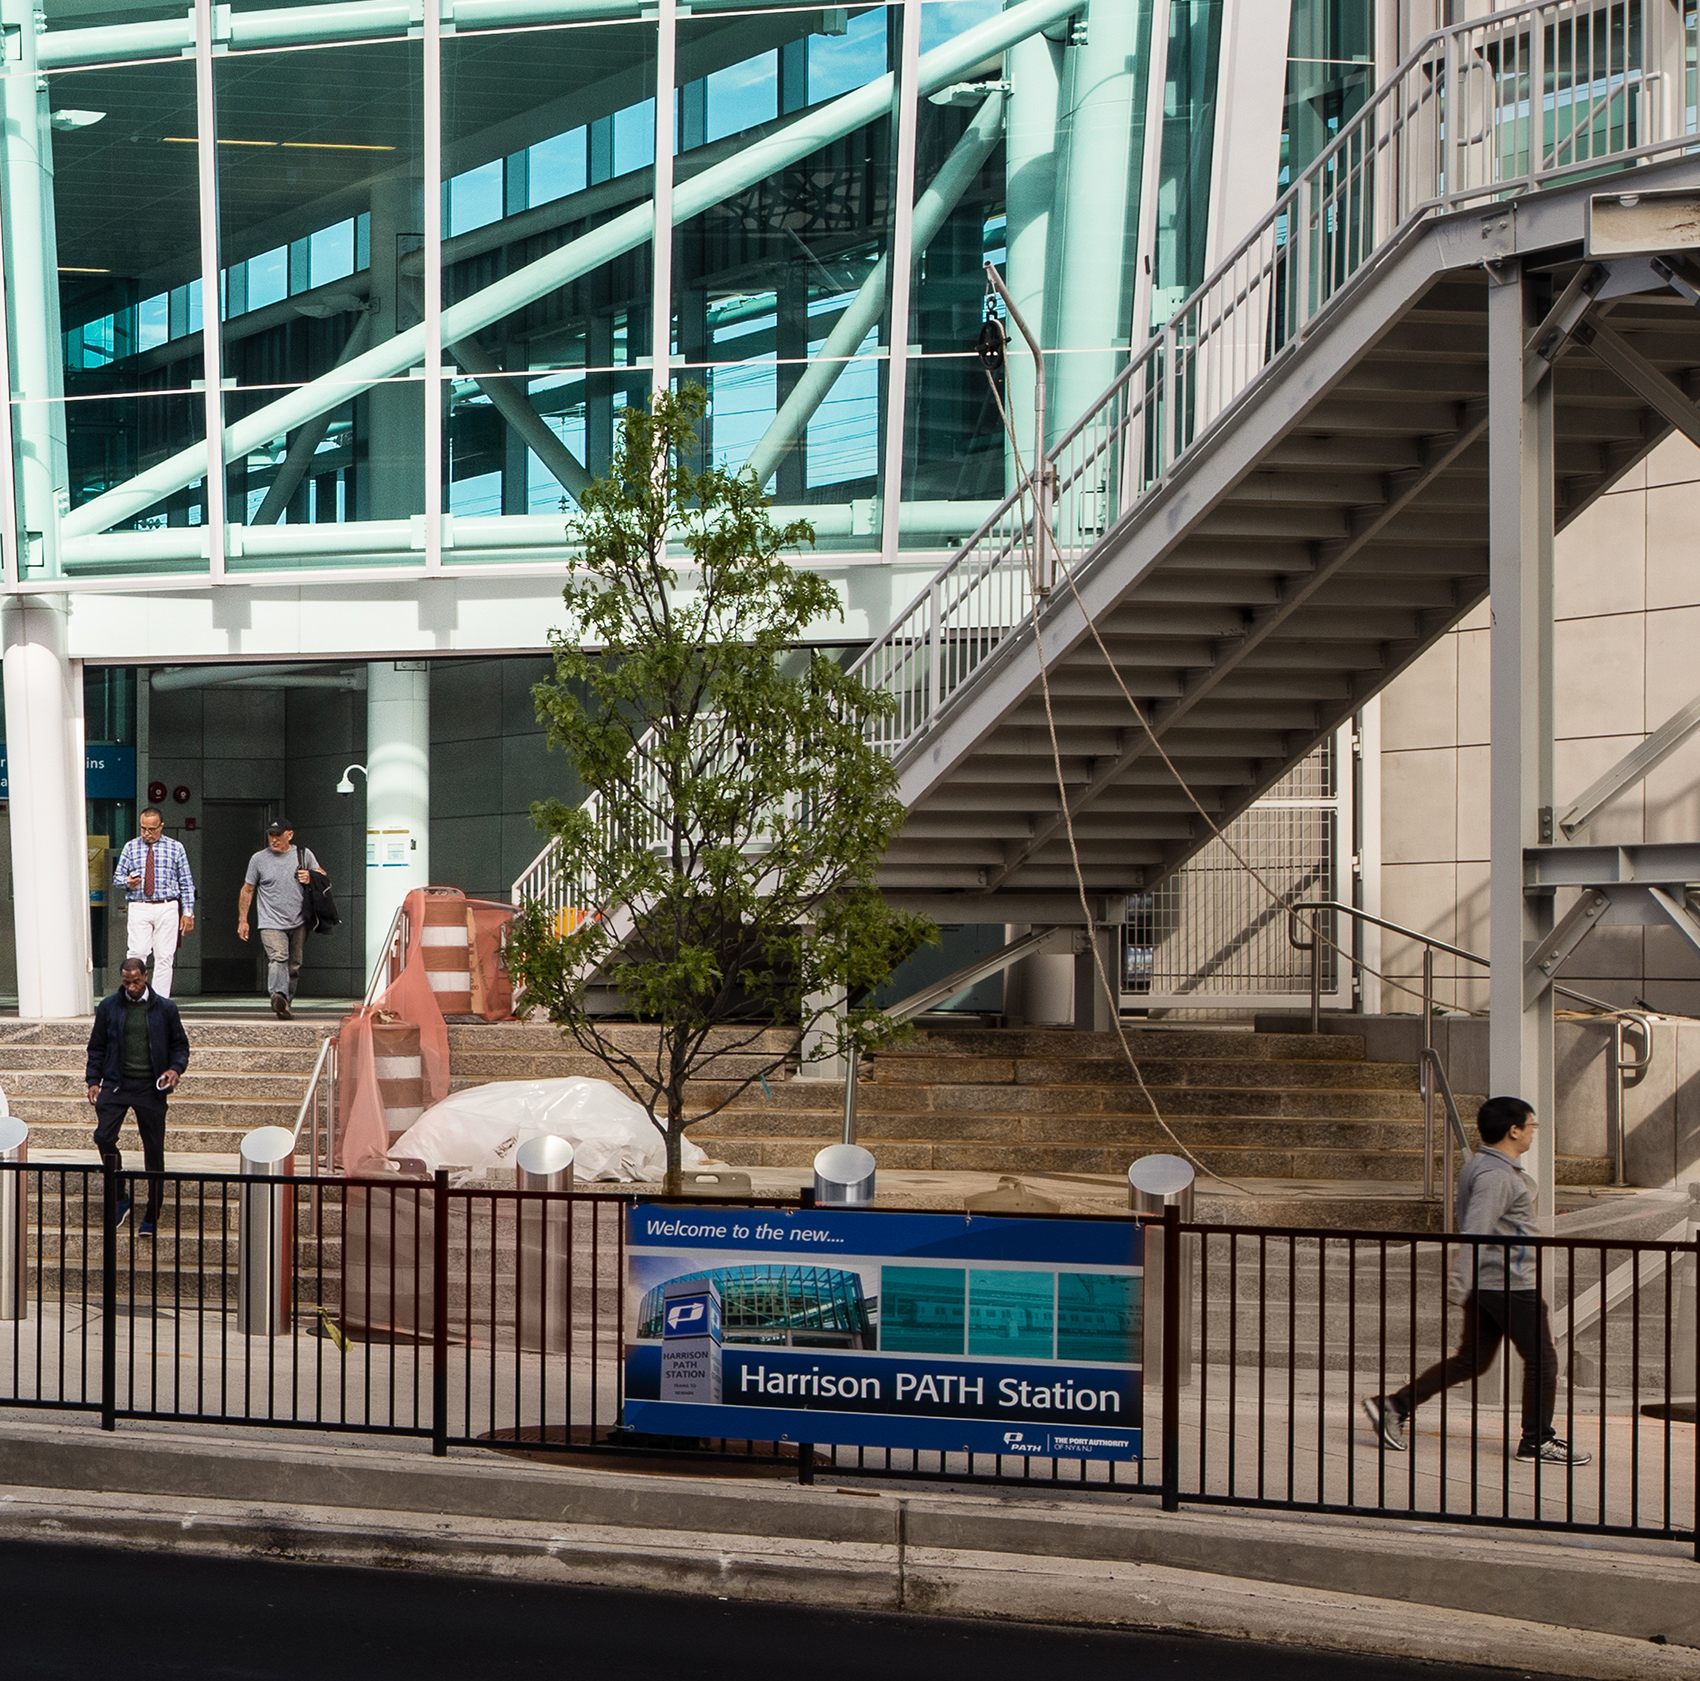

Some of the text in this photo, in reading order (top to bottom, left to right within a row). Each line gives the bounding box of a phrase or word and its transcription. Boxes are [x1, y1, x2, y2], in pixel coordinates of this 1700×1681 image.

[646, 1219, 727, 1238] Welcome
[732, 1224, 750, 1239] to
[755, 1223, 785, 1241] the
[663, 1351, 709, 1360] HARRISON
[673, 1361, 698, 1369] PATH
[665, 1370, 706, 1379] STATION
[740, 1364, 881, 1400] Harrison
[895, 1372, 984, 1405] PATH
[997, 1377, 1121, 1413] Station
[1054, 1436, 1129, 1448] THE PORT AUTHORITY
[1010, 1443, 1042, 1452] PATH
